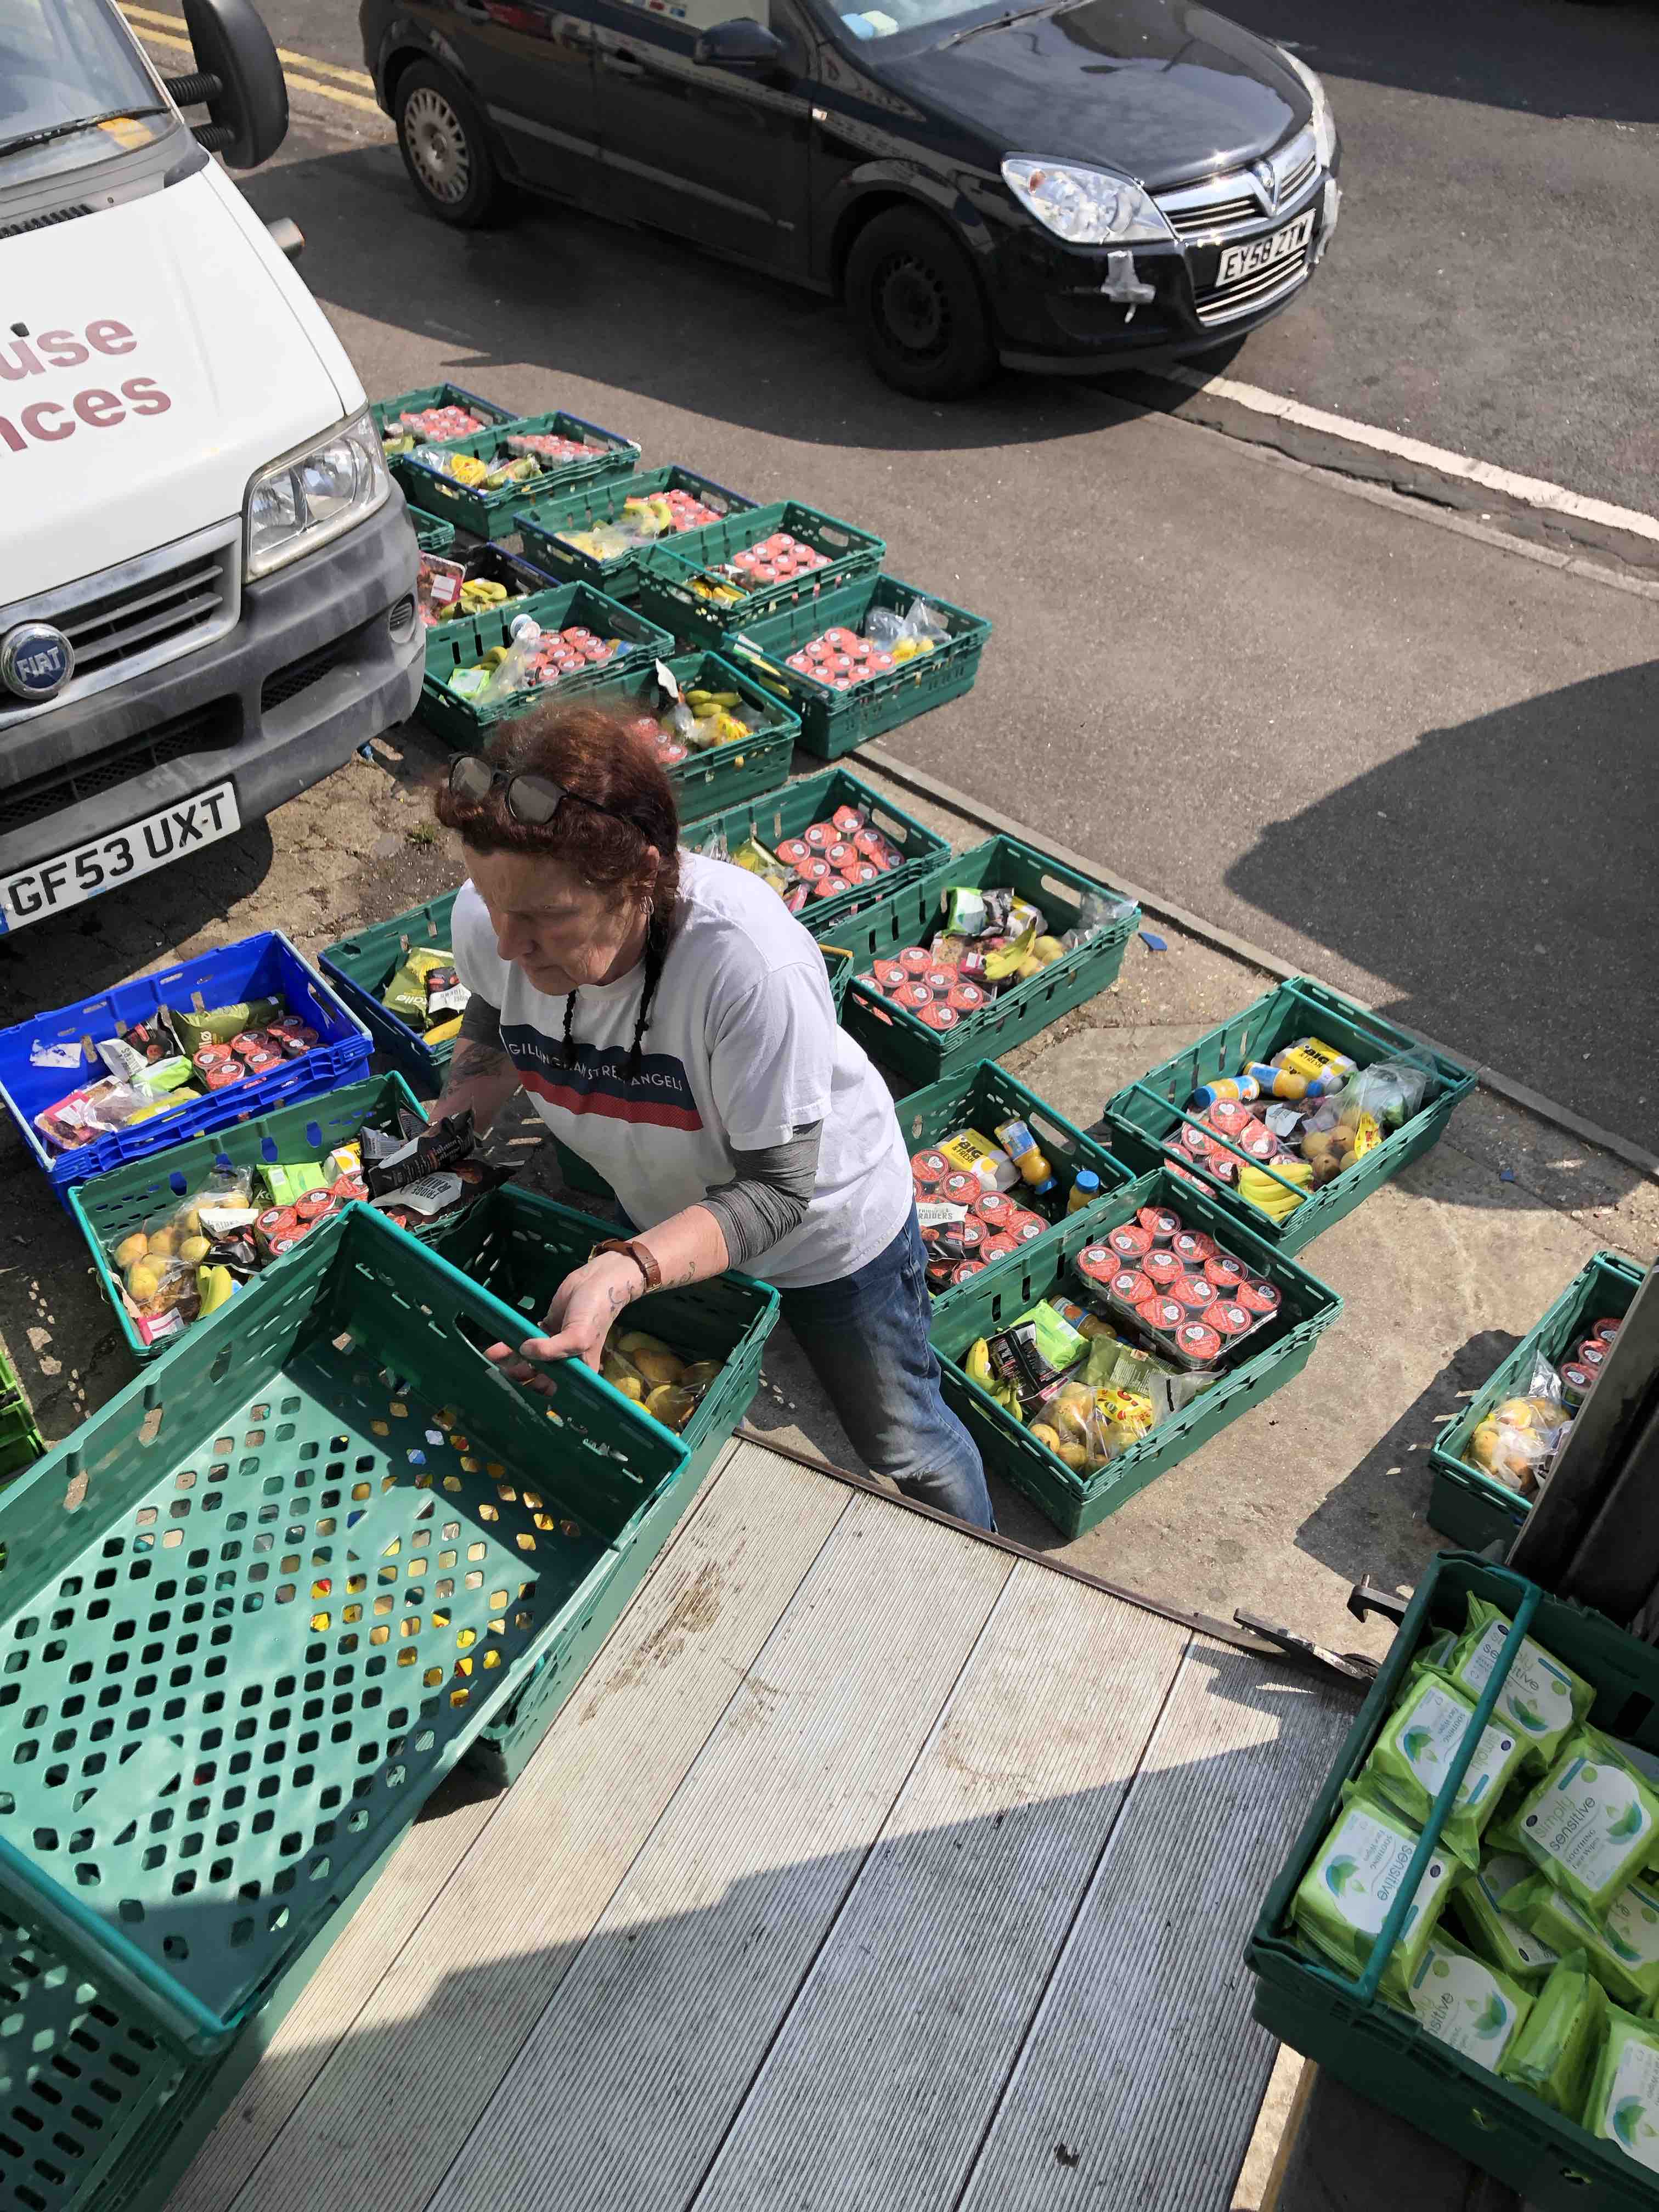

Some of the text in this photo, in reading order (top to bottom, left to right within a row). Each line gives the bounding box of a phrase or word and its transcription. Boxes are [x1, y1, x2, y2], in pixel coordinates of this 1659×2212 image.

[1224, 237, 1273, 280] EY58
[0, 320, 137, 380] use
[16, 646, 61, 681] FIAT
[8, 792, 224, 916] GF53 UXT
[509, 1043, 587, 1079] GILLINGAM
[588, 1065, 627, 1084] STRE
[956, 1148, 975, 1164] FRESH
[957, 1142, 984, 1159] BIG
[411, 1186, 439, 1199] FRIDGE
[1483, 1644, 1539, 1691] seitive
[1534, 1796, 1576, 1838] simply
[1549, 1797, 1595, 1851] sensitive
[1377, 1844, 1413, 1901] sensitive
